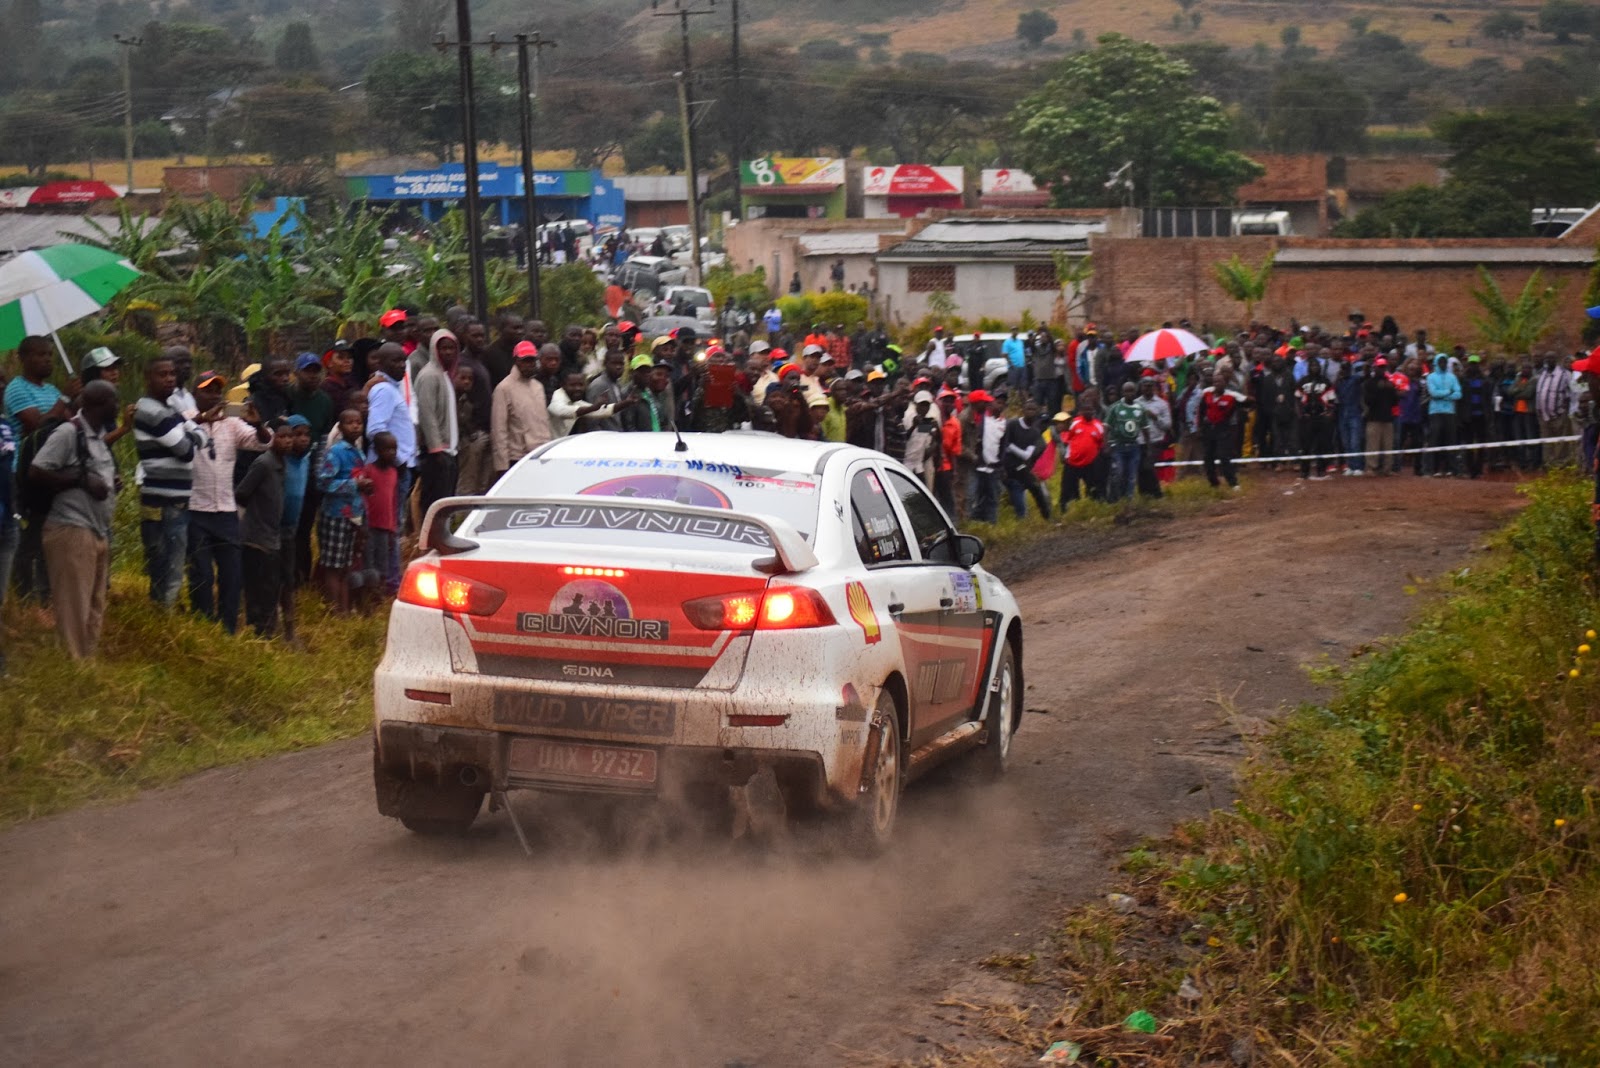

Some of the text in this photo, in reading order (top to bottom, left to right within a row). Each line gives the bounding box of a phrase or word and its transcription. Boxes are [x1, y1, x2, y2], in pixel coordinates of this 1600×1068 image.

[506, 508, 770, 547] GUVNOR
[523, 613, 661, 639] GUVNOR
[501, 696, 669, 732] MUD VIPER
